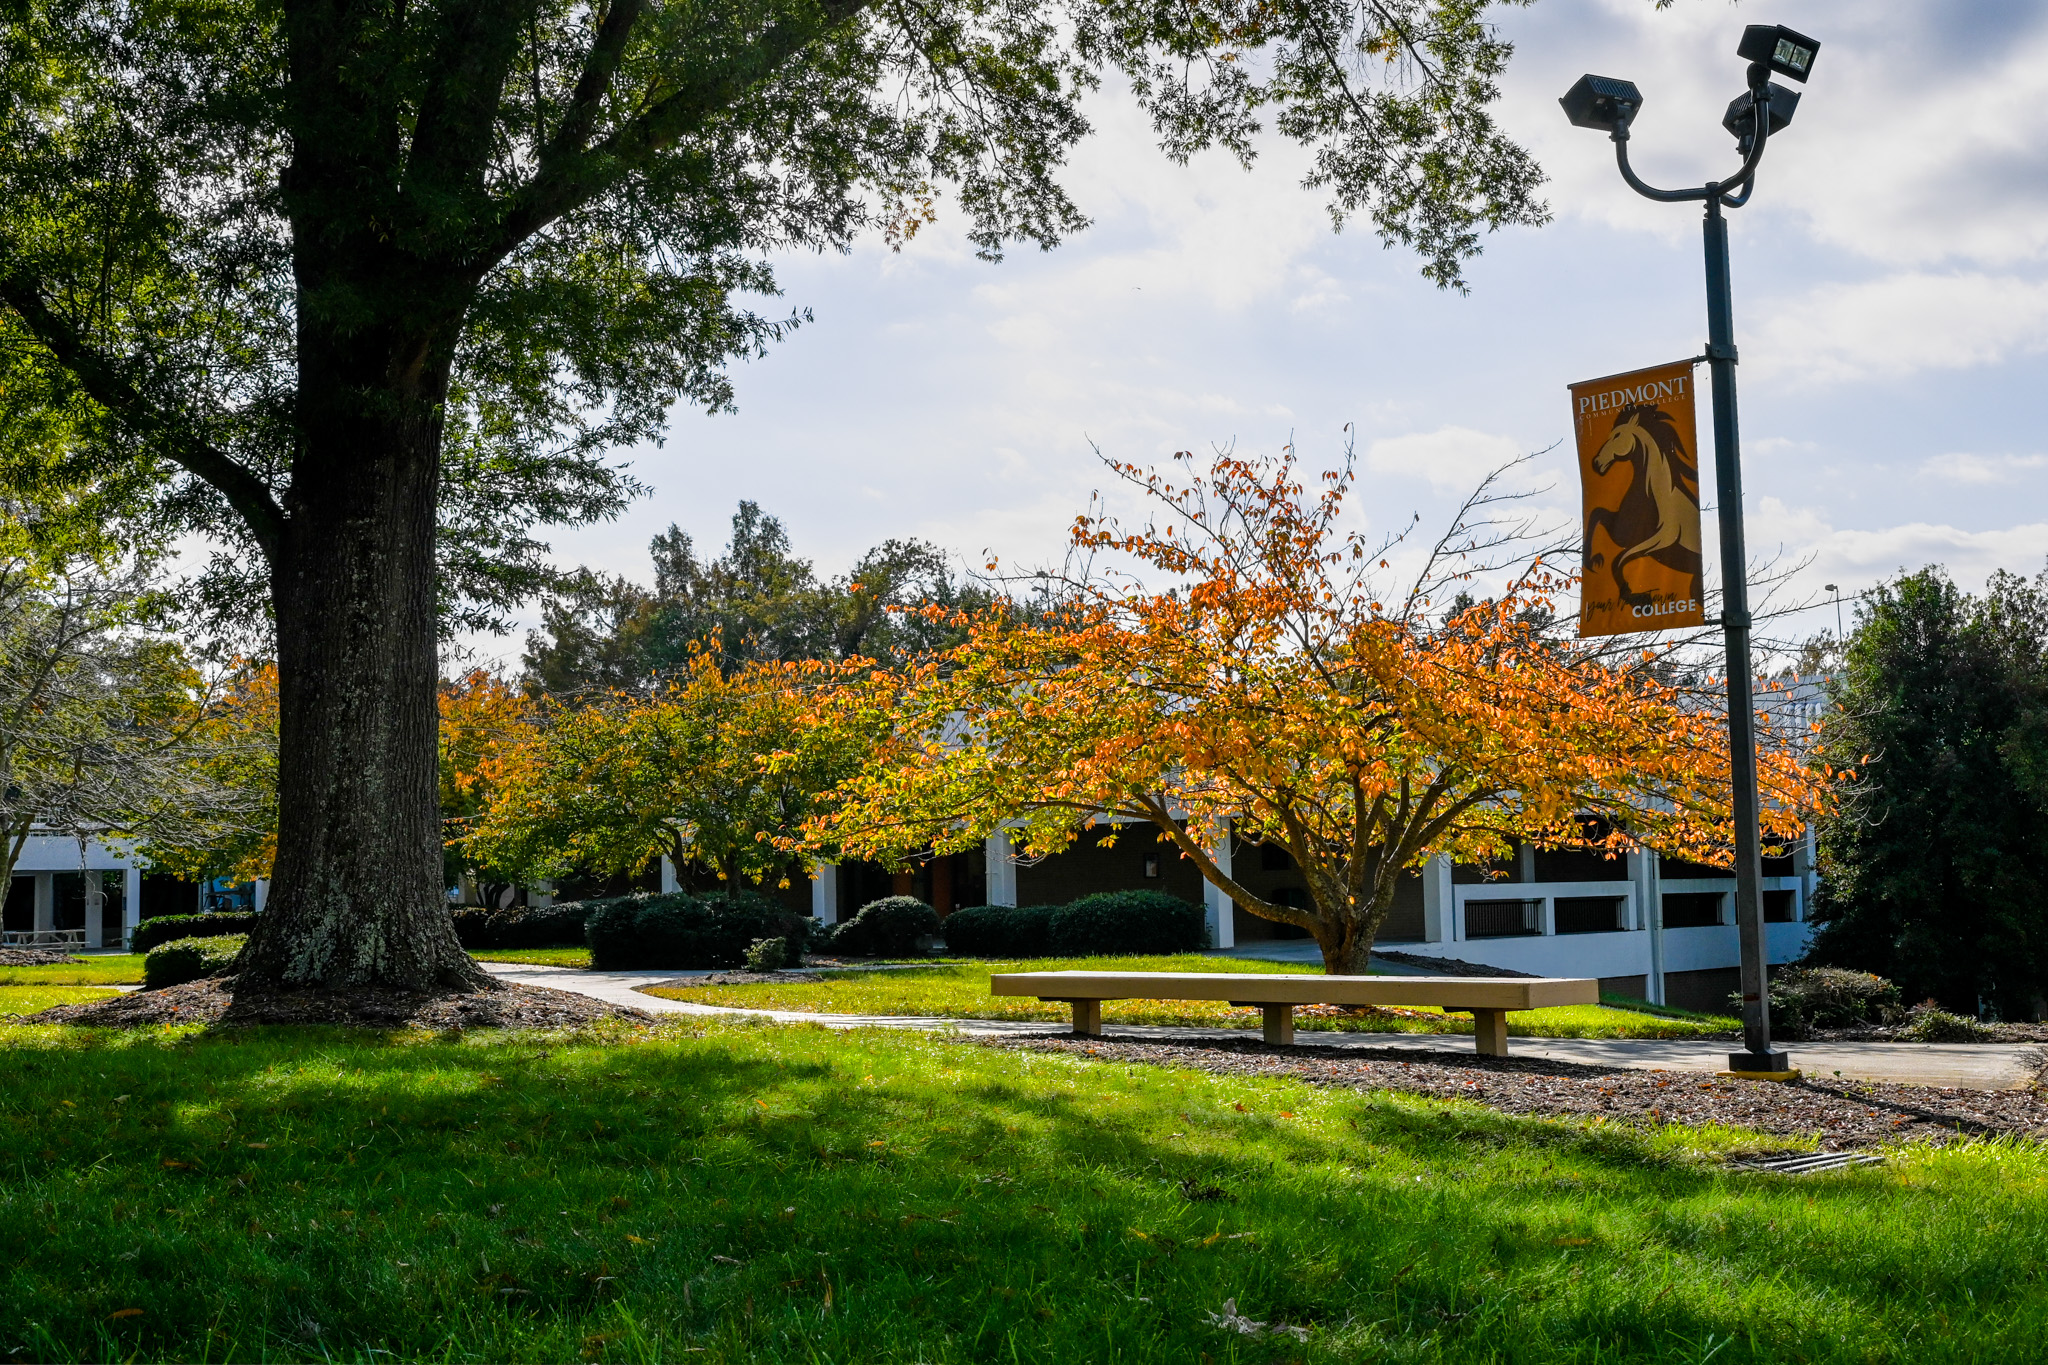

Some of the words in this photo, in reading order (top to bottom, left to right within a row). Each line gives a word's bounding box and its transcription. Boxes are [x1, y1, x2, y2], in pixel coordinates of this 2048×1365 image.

[1578, 376, 1688, 414] PIEDMONT
[1579, 404, 1637, 420] COMMUNITY
[1643, 394, 1686, 408] COLLEGE
[1632, 599, 1696, 618] COLLEGE
